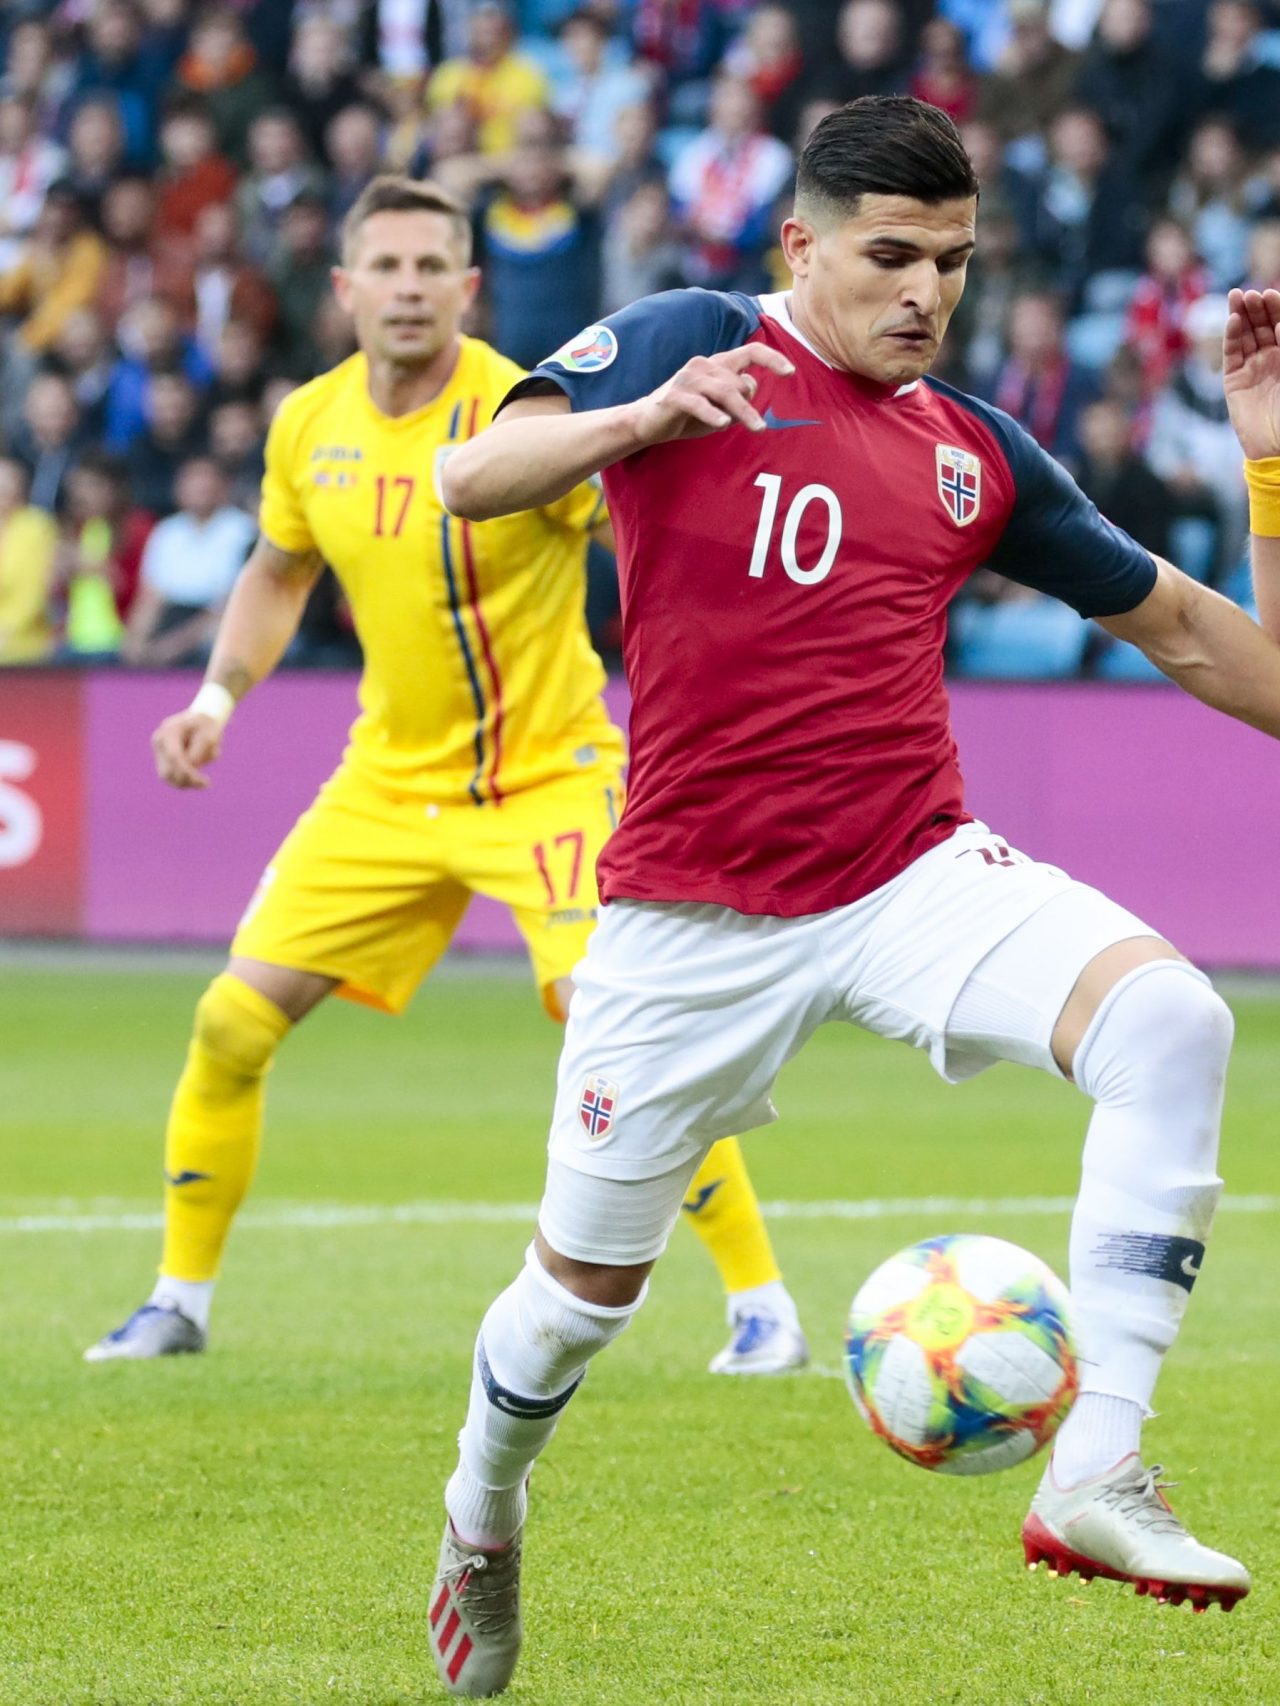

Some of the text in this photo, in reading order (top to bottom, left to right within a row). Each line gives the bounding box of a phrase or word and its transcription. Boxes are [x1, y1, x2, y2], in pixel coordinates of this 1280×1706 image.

[374, 476, 414, 537] 17
[748, 472, 843, 585] 10
[533, 830, 584, 905] 17
